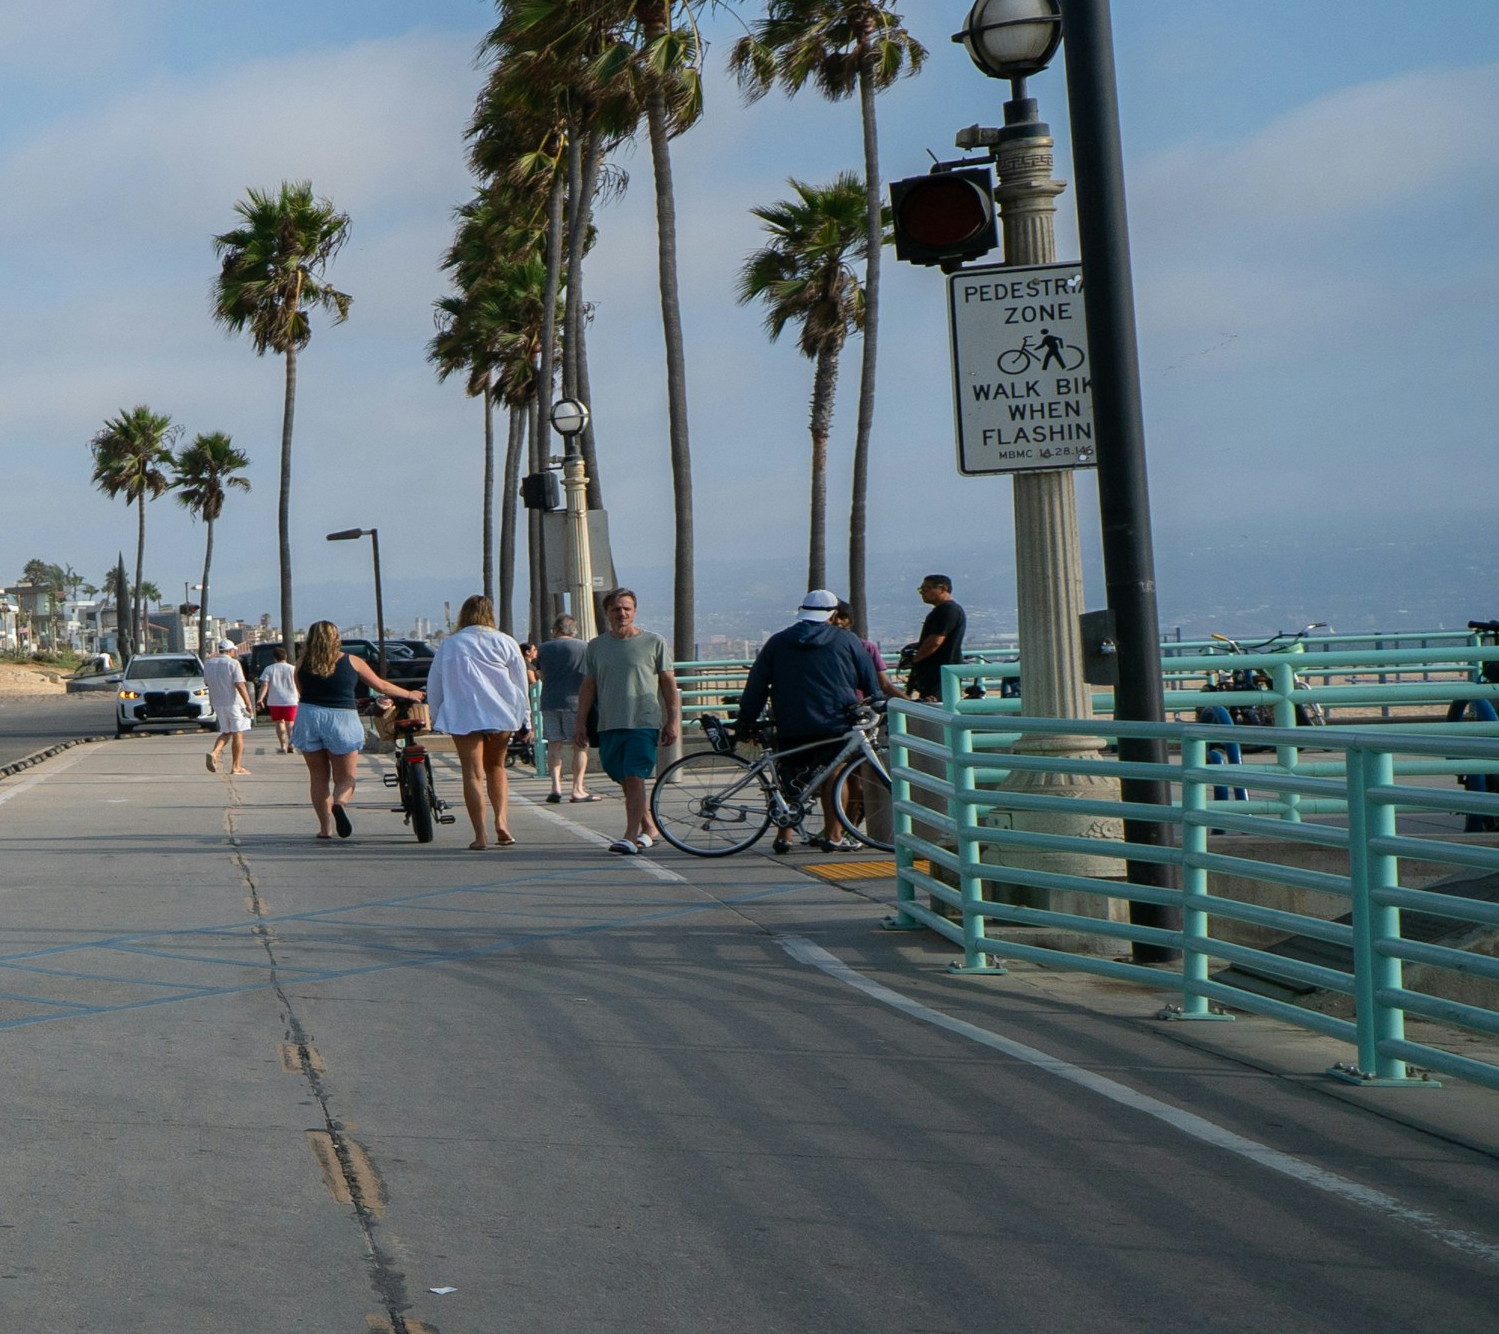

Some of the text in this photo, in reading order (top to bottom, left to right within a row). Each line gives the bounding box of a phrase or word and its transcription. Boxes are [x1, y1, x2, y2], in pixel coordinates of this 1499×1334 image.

[965, 278, 1083, 303] PEDESTRI
[1004, 303, 1072, 324] ZONE
[972, 377, 1092, 401] WALK BIK
[1008, 400, 1081, 421] WHEN
[982, 422, 1091, 446] FLASHIN
[999, 449, 1033, 460] MBMC
